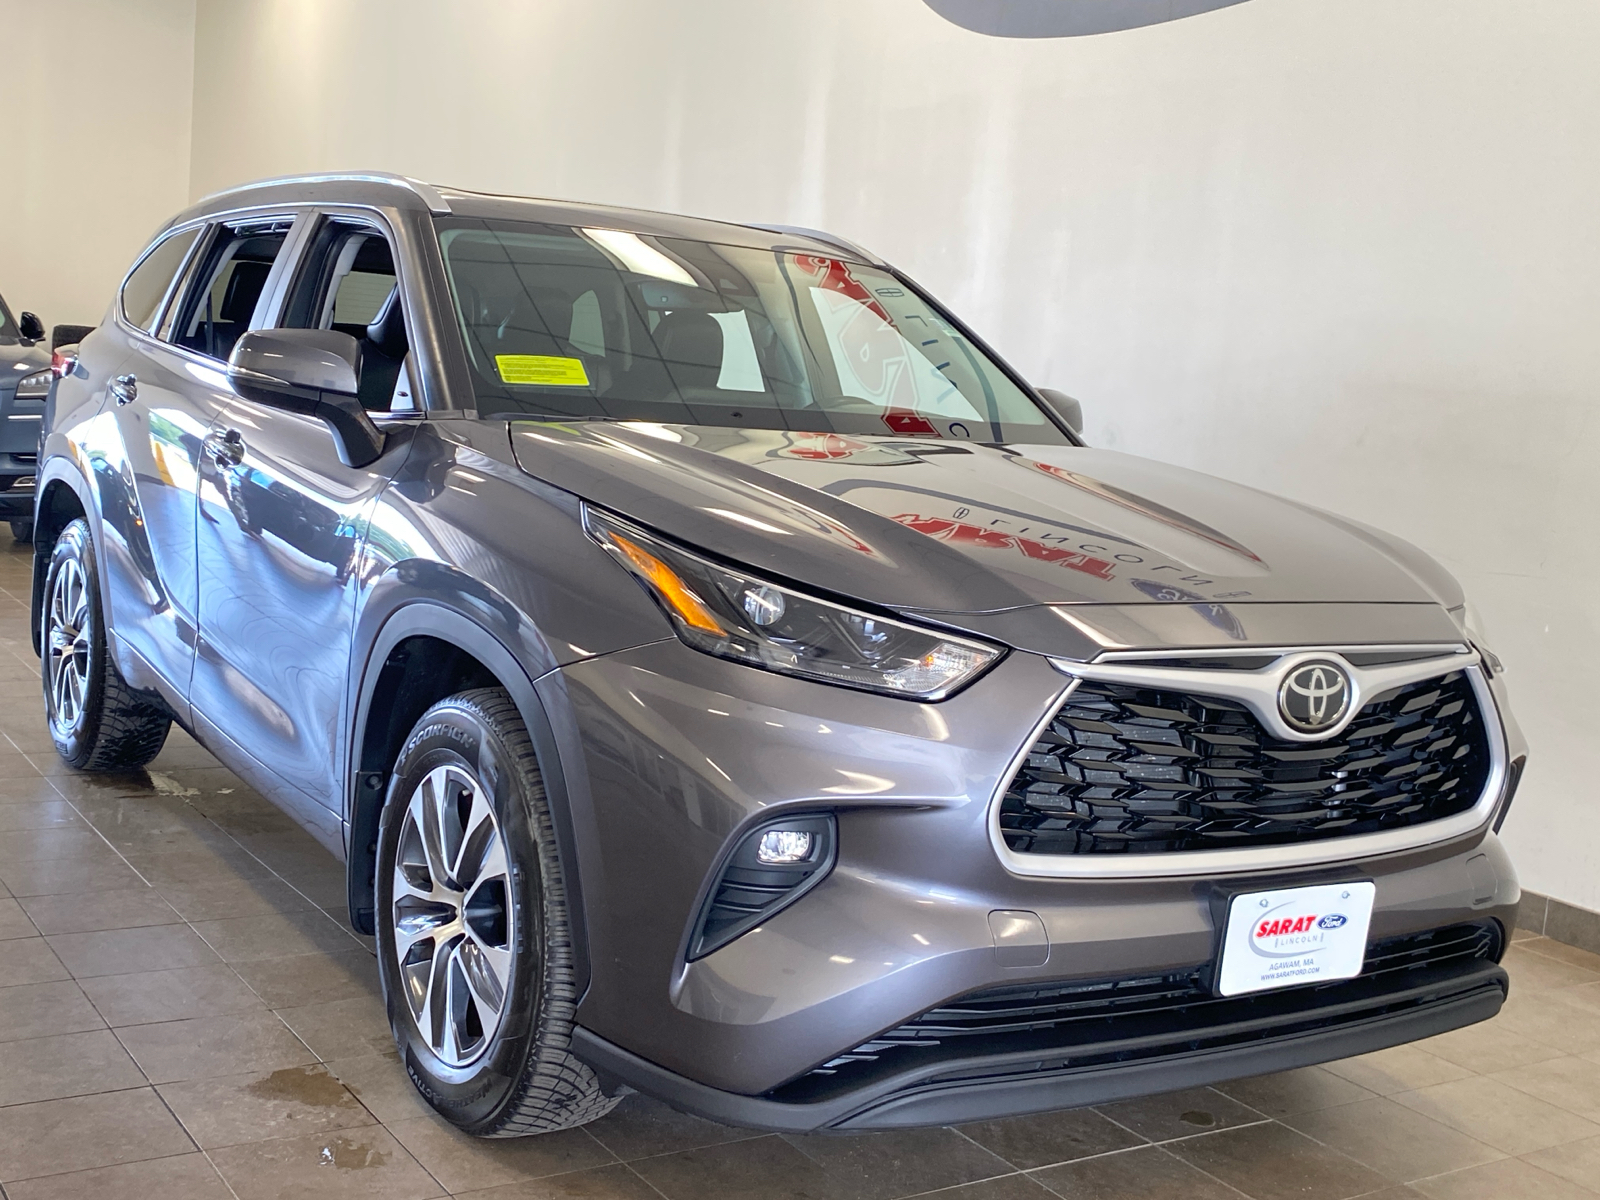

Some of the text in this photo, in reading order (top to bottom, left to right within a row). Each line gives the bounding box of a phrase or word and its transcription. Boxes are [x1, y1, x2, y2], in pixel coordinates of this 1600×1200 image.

[1256, 914, 1318, 938] SARAT
[1280, 935, 1318, 946] LINCOLN
[1269, 960, 1301, 971] AGAWAM,
[1261, 967, 1320, 981] WWW.SARATFORD.COM
